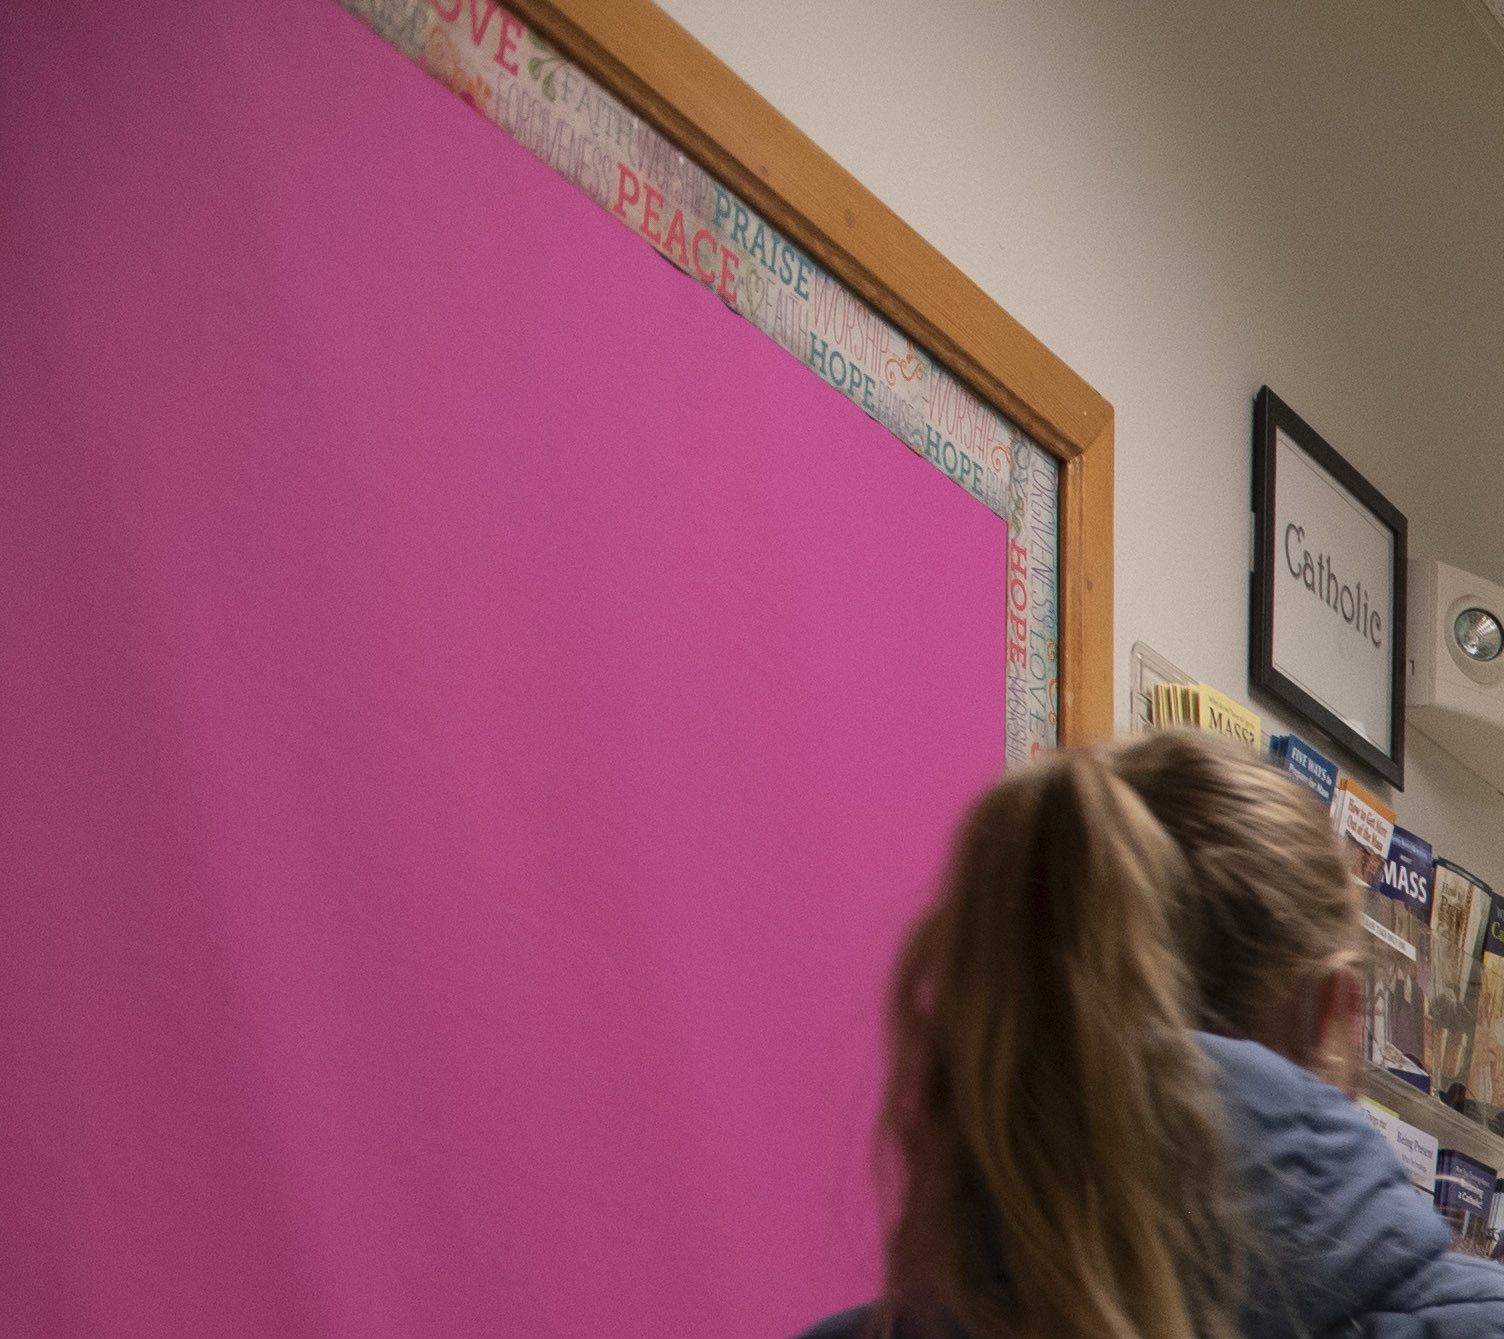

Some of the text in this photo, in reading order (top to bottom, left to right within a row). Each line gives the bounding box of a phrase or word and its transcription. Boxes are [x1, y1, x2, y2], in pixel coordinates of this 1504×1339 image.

[613, 161, 740, 304] PEACE
[808, 331, 877, 412] HOPE
[924, 424, 986, 498] HOPE
[713, 184, 997, 466] PRAISE WORSHIP WORSHIP
[1010, 539, 1028, 669] HOPE
[1284, 522, 1382, 651] Catholic
[1027, 628, 1046, 739] LOVE
[1291, 746, 1308, 768] FIVE
[1381, 859, 1428, 904] MASS
